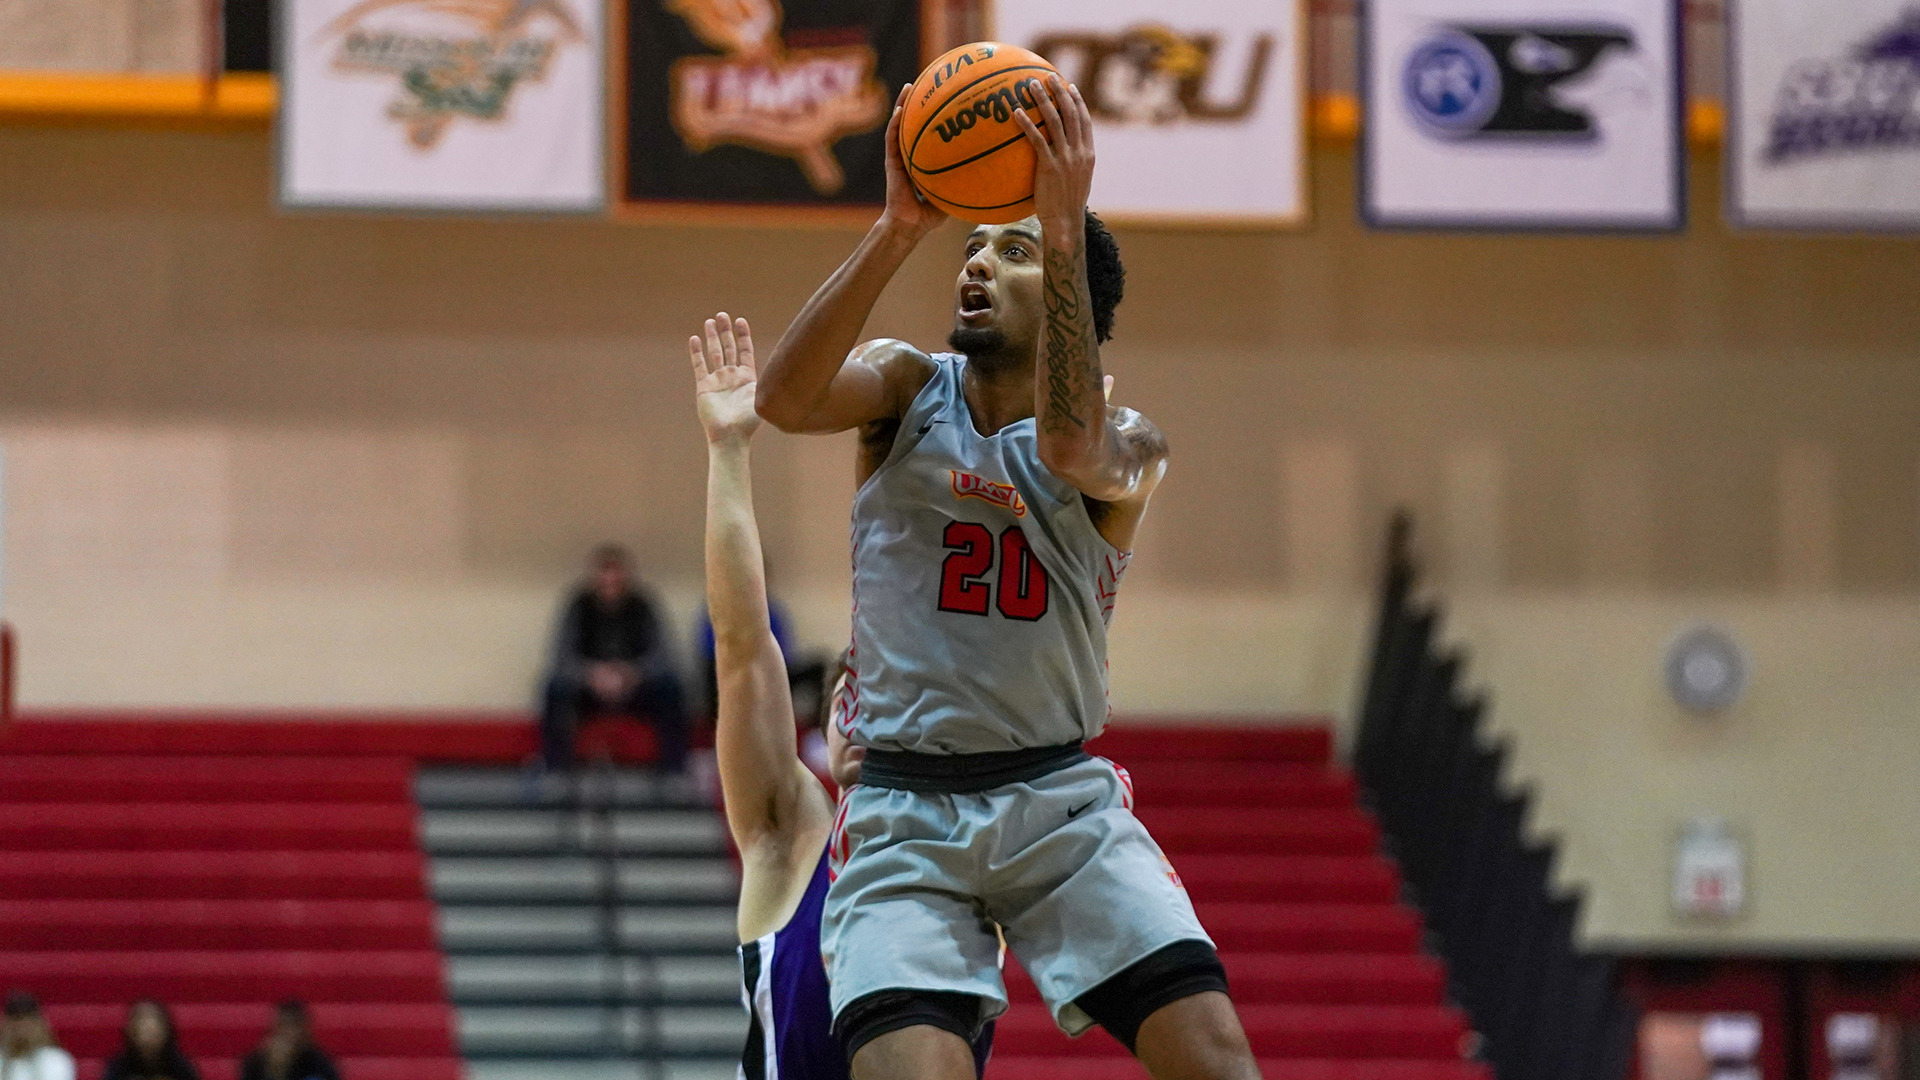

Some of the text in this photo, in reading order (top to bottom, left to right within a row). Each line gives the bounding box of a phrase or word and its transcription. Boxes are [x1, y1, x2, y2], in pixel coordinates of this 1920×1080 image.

[934, 46, 995, 89] EVO
[934, 78, 1052, 143] Wilson
[951, 470, 1026, 517] UMSL
[937, 519, 1049, 622] 20
